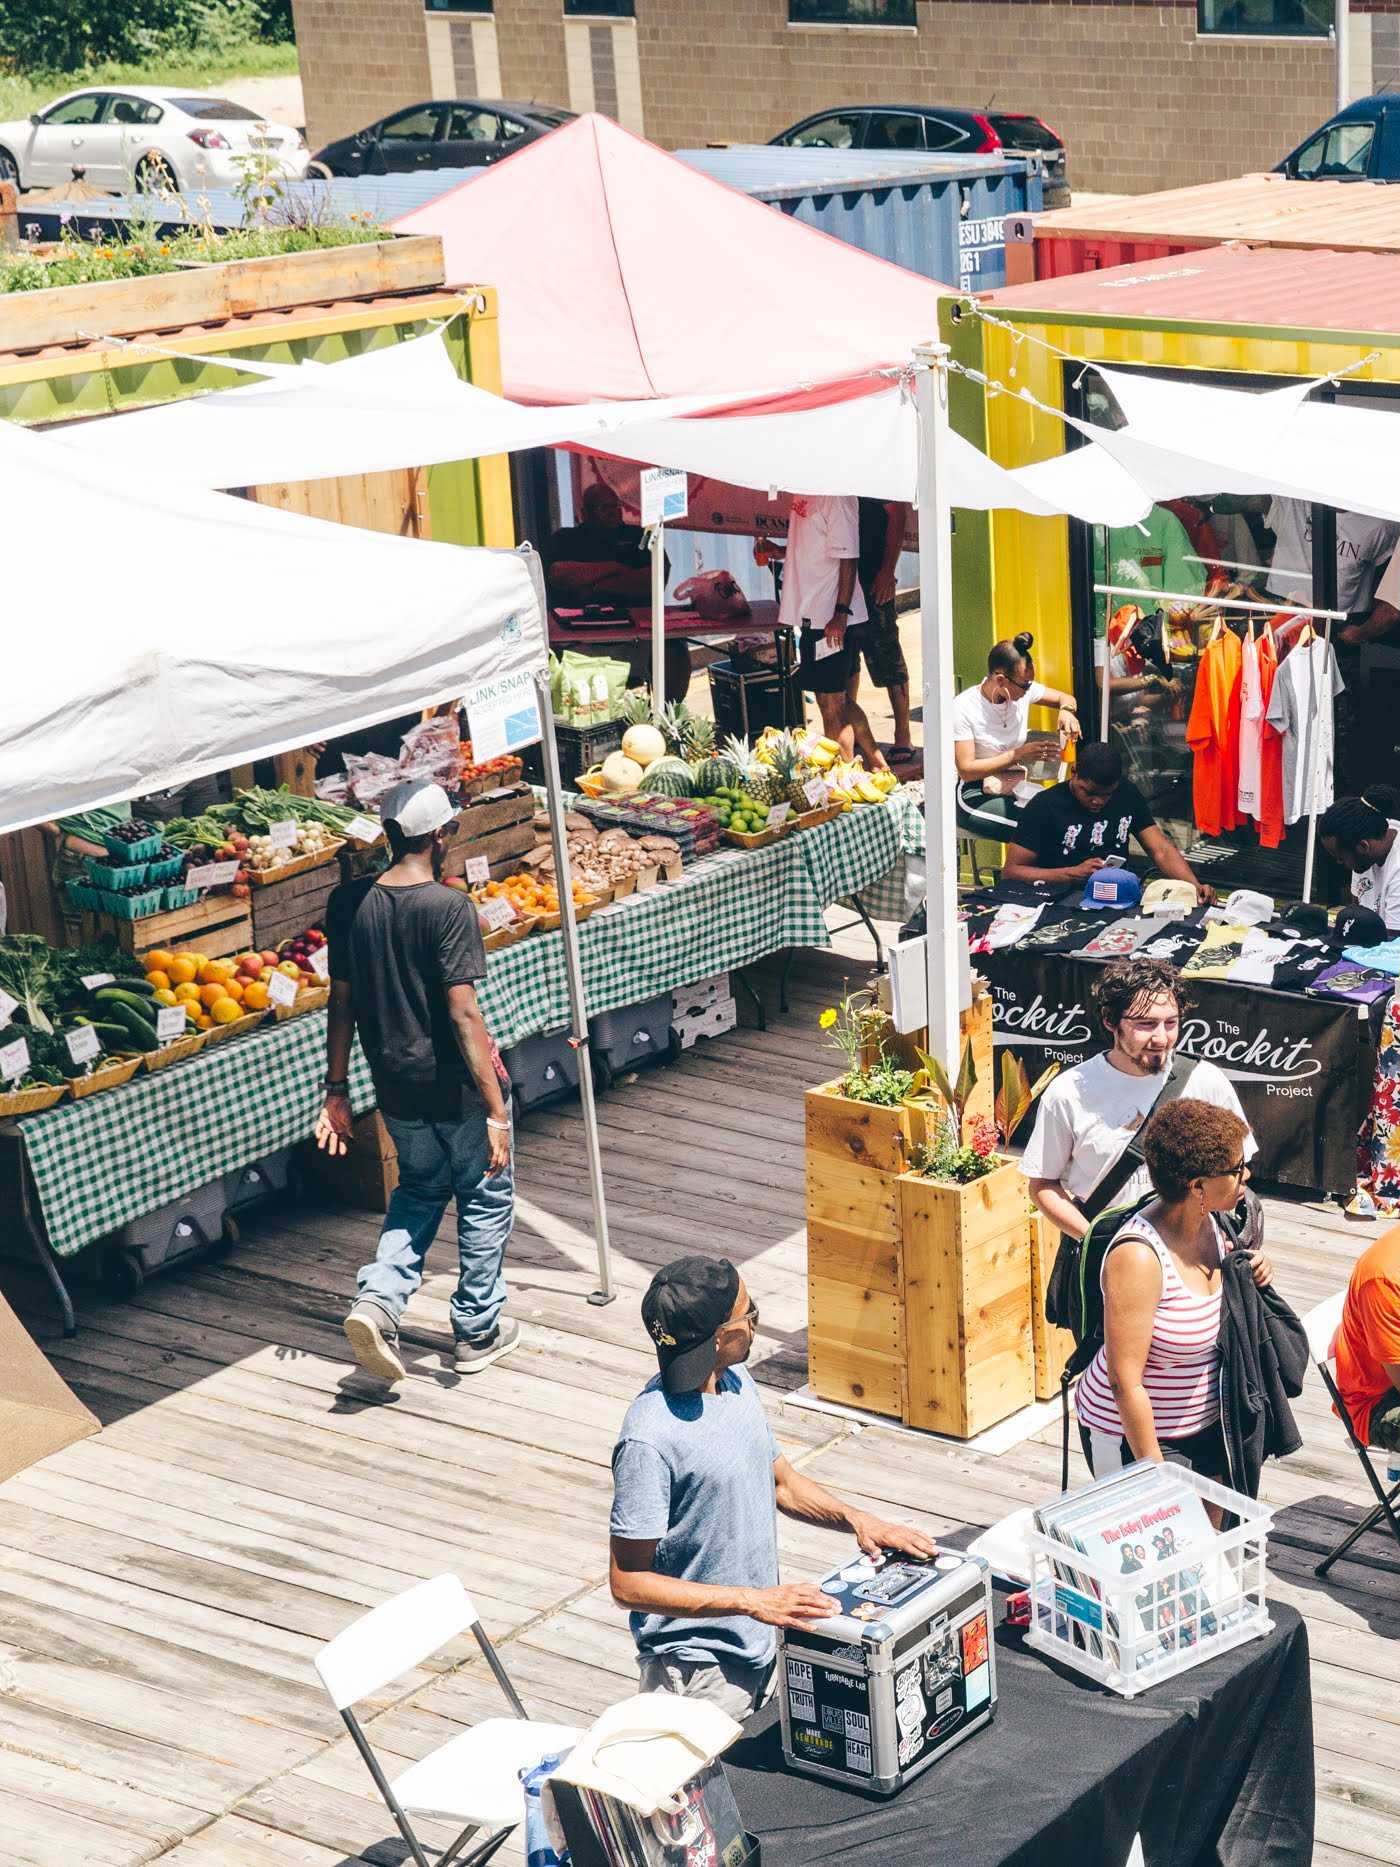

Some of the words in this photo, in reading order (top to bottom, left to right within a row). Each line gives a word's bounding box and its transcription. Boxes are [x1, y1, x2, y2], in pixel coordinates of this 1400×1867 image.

[995, 986, 1016, 1001] The
[992, 995, 1092, 1041] ockit
[1216, 1020, 1240, 1035] The
[1175, 1019, 1321, 1073] Rockit
[1044, 1048, 1084, 1064] Project
[1267, 1084, 1313, 1099] Project
[1101, 1529, 1121, 1545] The
[1119, 1519, 1143, 1538] Isley
[1140, 1503, 1181, 1529] Brothers
[788, 1661, 812, 1680] HOPE
[825, 1671, 854, 1690] TURNTABLE
[855, 1681, 867, 1691] LAB
[791, 1691, 814, 1709] TRUTH
[845, 1711, 869, 1731] SOUL
[795, 1730, 833, 1750] LEMONADE
[806, 1727, 821, 1738] MAKE
[846, 1740, 870, 1759] HEART
